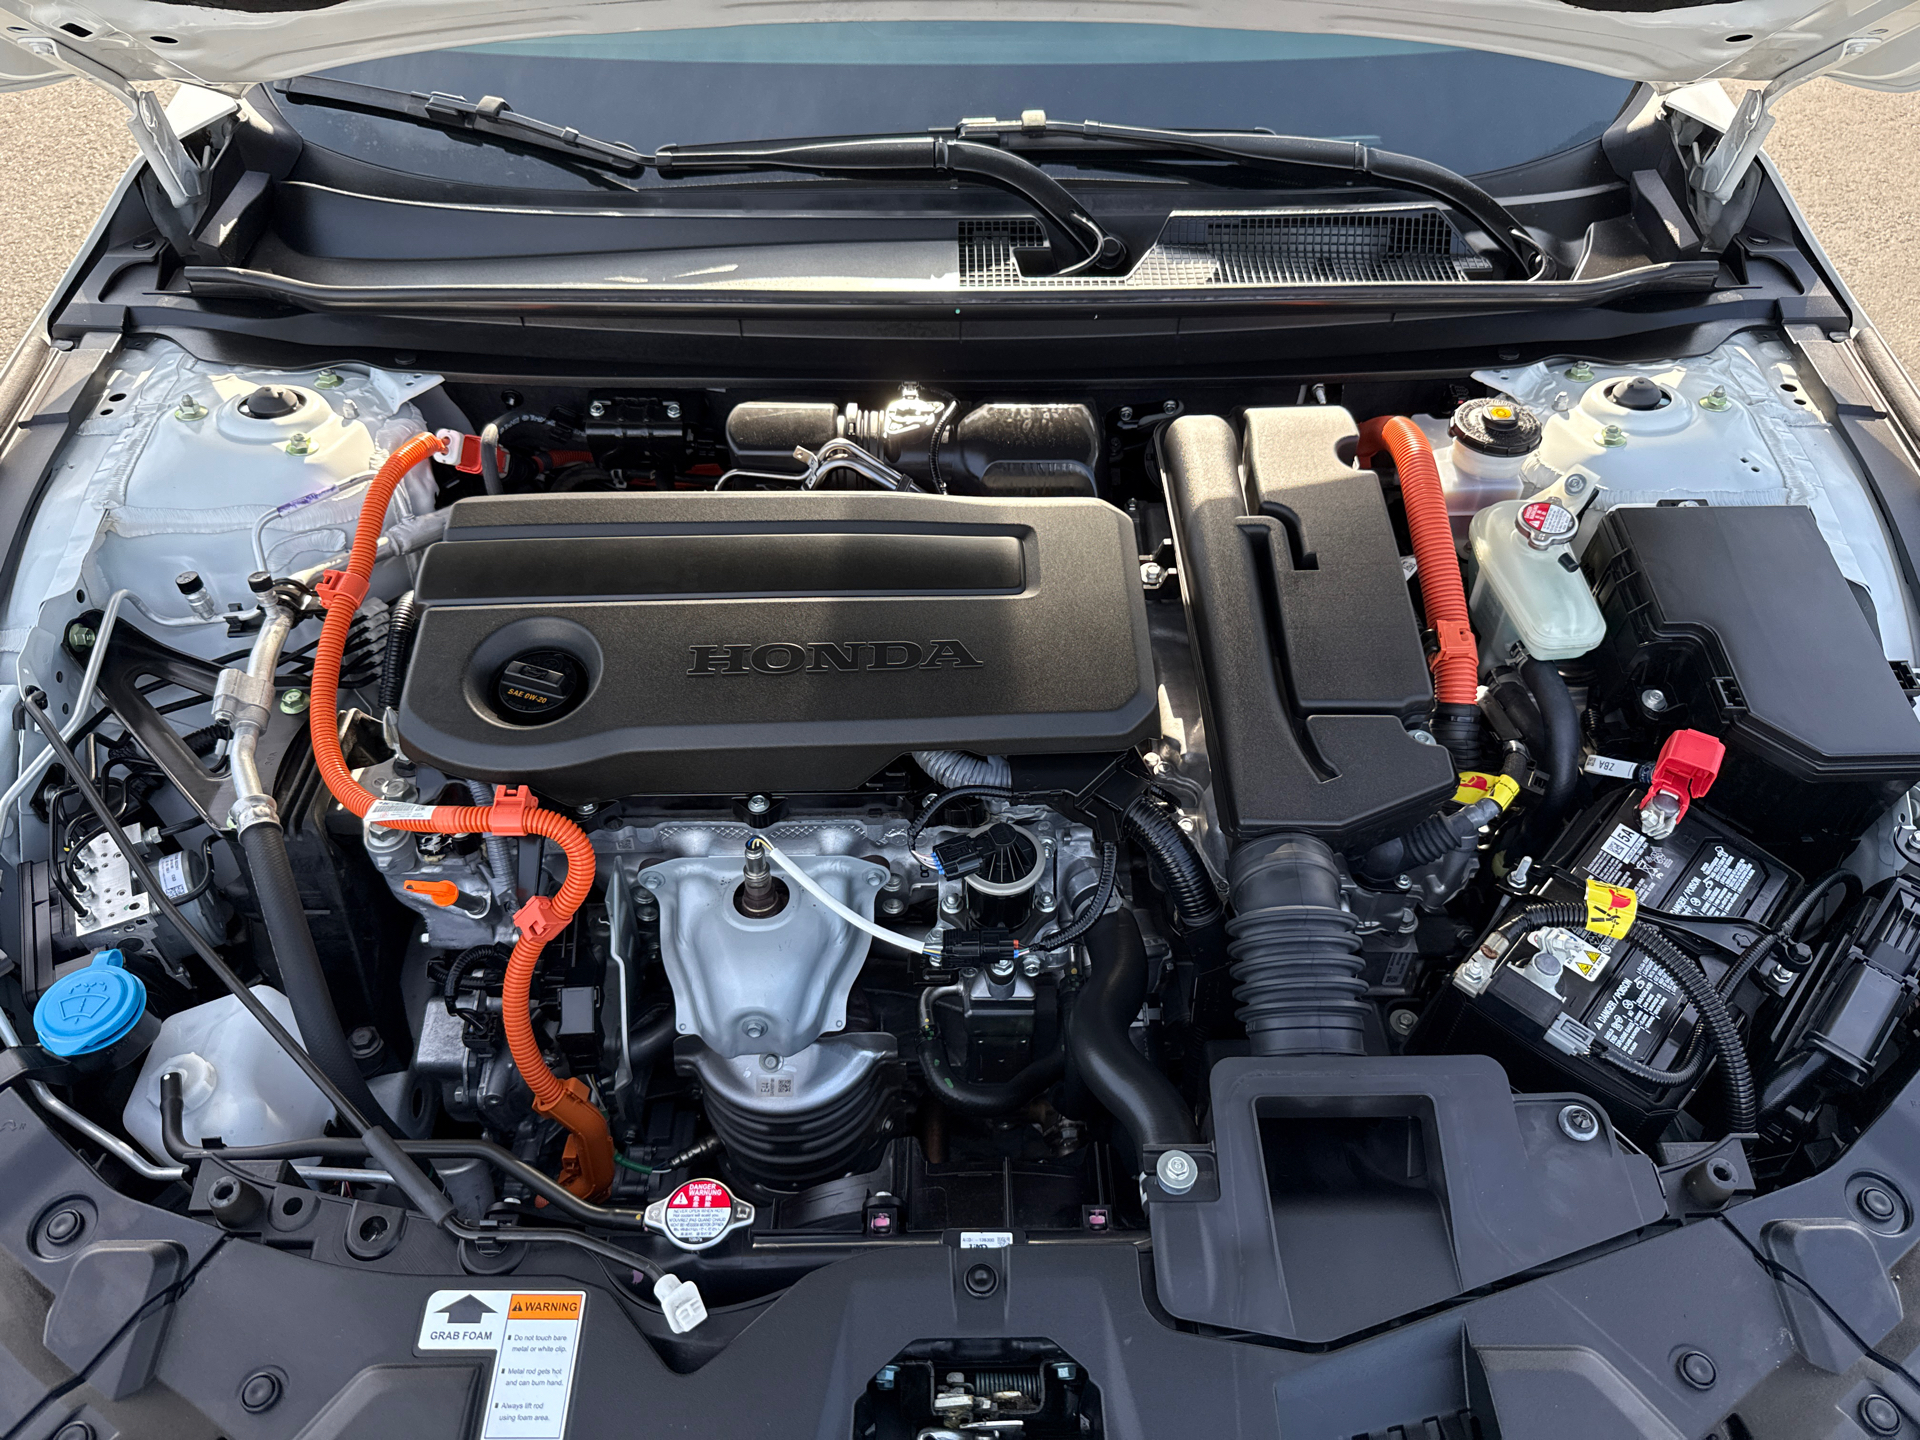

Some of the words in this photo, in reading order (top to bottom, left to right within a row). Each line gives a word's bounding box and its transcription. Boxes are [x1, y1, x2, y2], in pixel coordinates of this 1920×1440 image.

[686, 639, 984, 675] HONDA
[507, 688, 525, 698] SAE
[524, 693, 547, 704] 0W-20
[1598, 760, 1615, 772] ZBA
[1617, 828, 1635, 843] 5A
[525, 1302, 578, 1312] WARNING
[430, 1331, 460, 1340] GRAB
[462, 1331, 493, 1340] FOAM
[537, 1368, 551, 1376] gets
[501, 1402, 523, 1410] Always
